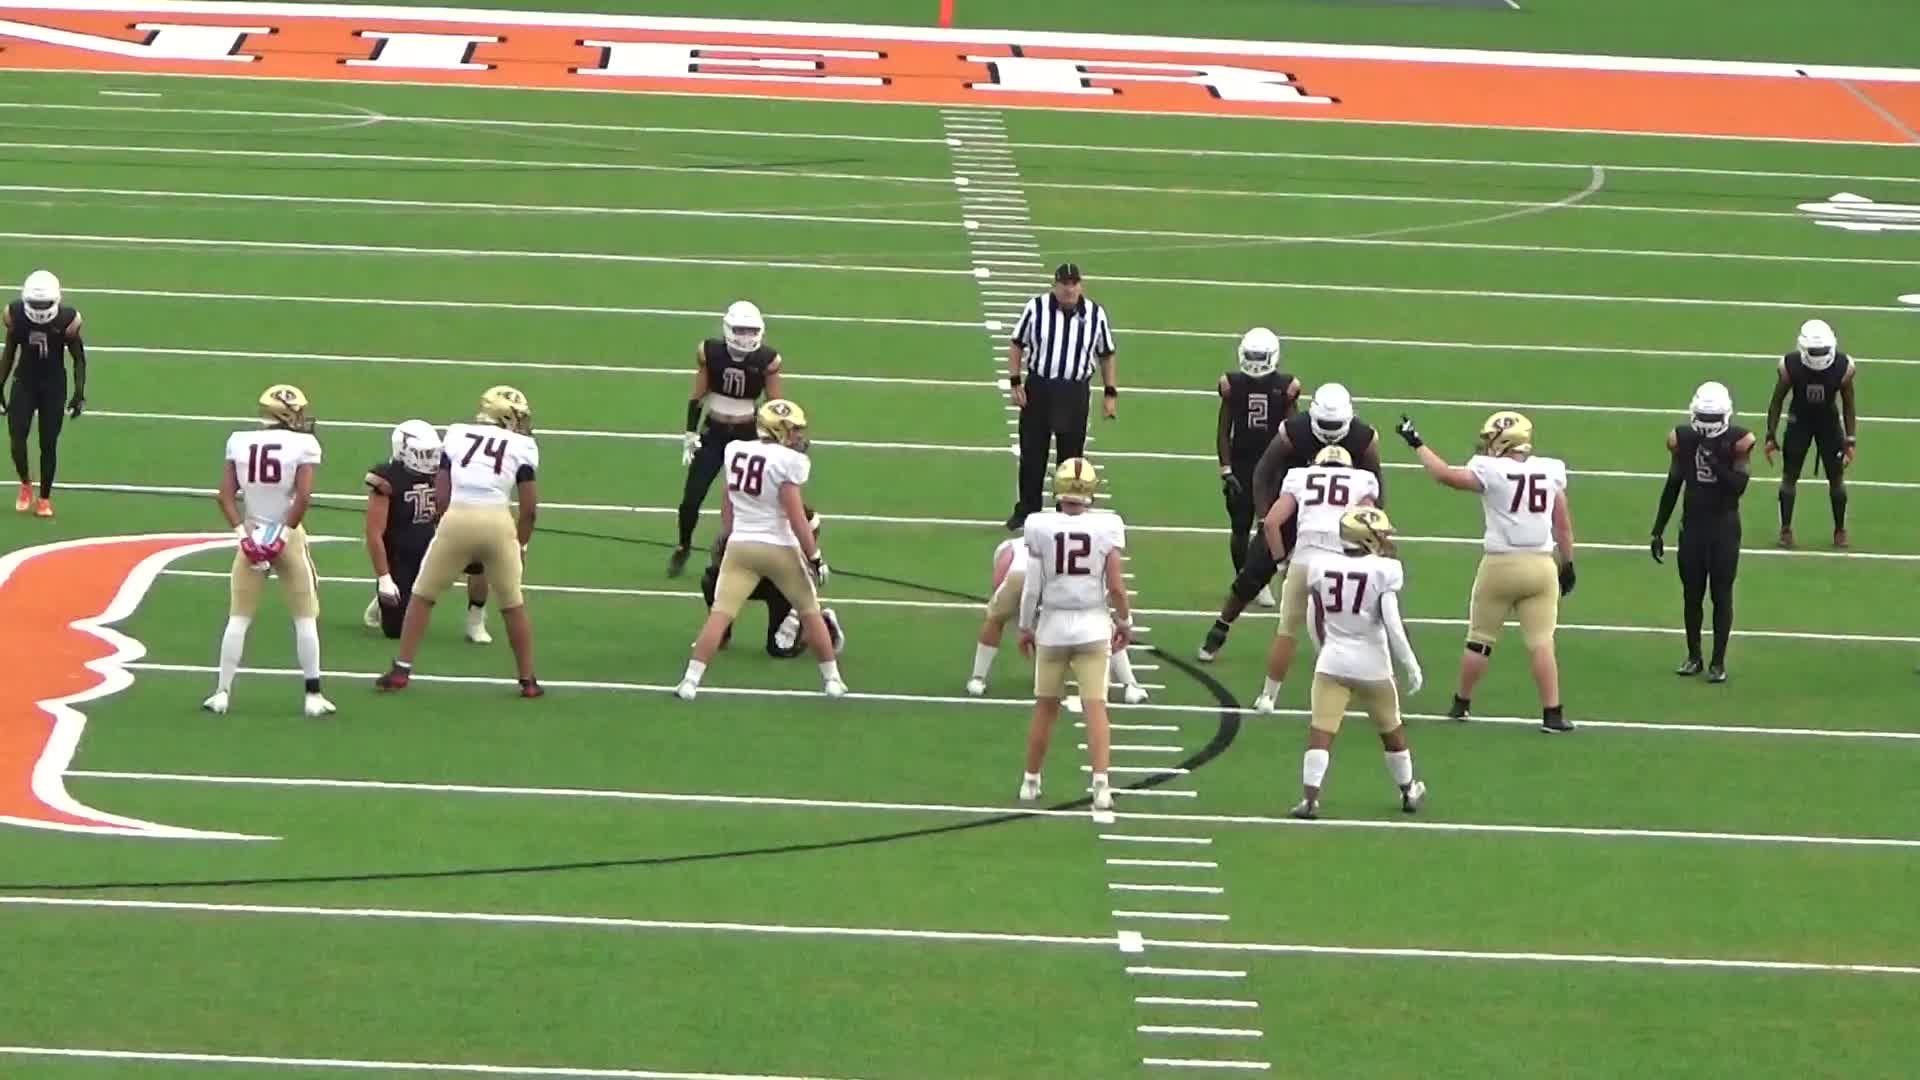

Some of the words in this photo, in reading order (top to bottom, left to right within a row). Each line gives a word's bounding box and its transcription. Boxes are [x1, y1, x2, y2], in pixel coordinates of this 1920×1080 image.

[29, 330, 49, 359] 7
[1248, 393, 1269, 429] 2
[247, 443, 282, 484] 16
[460, 432, 508, 475] 74
[728, 451, 766, 496] 58
[404, 483, 438, 524] 75
[1304, 474, 1351, 507] 56
[1506, 473, 1548, 514] 76
[1053, 531, 1092, 576] 12
[1323, 570, 1370, 615] 37
